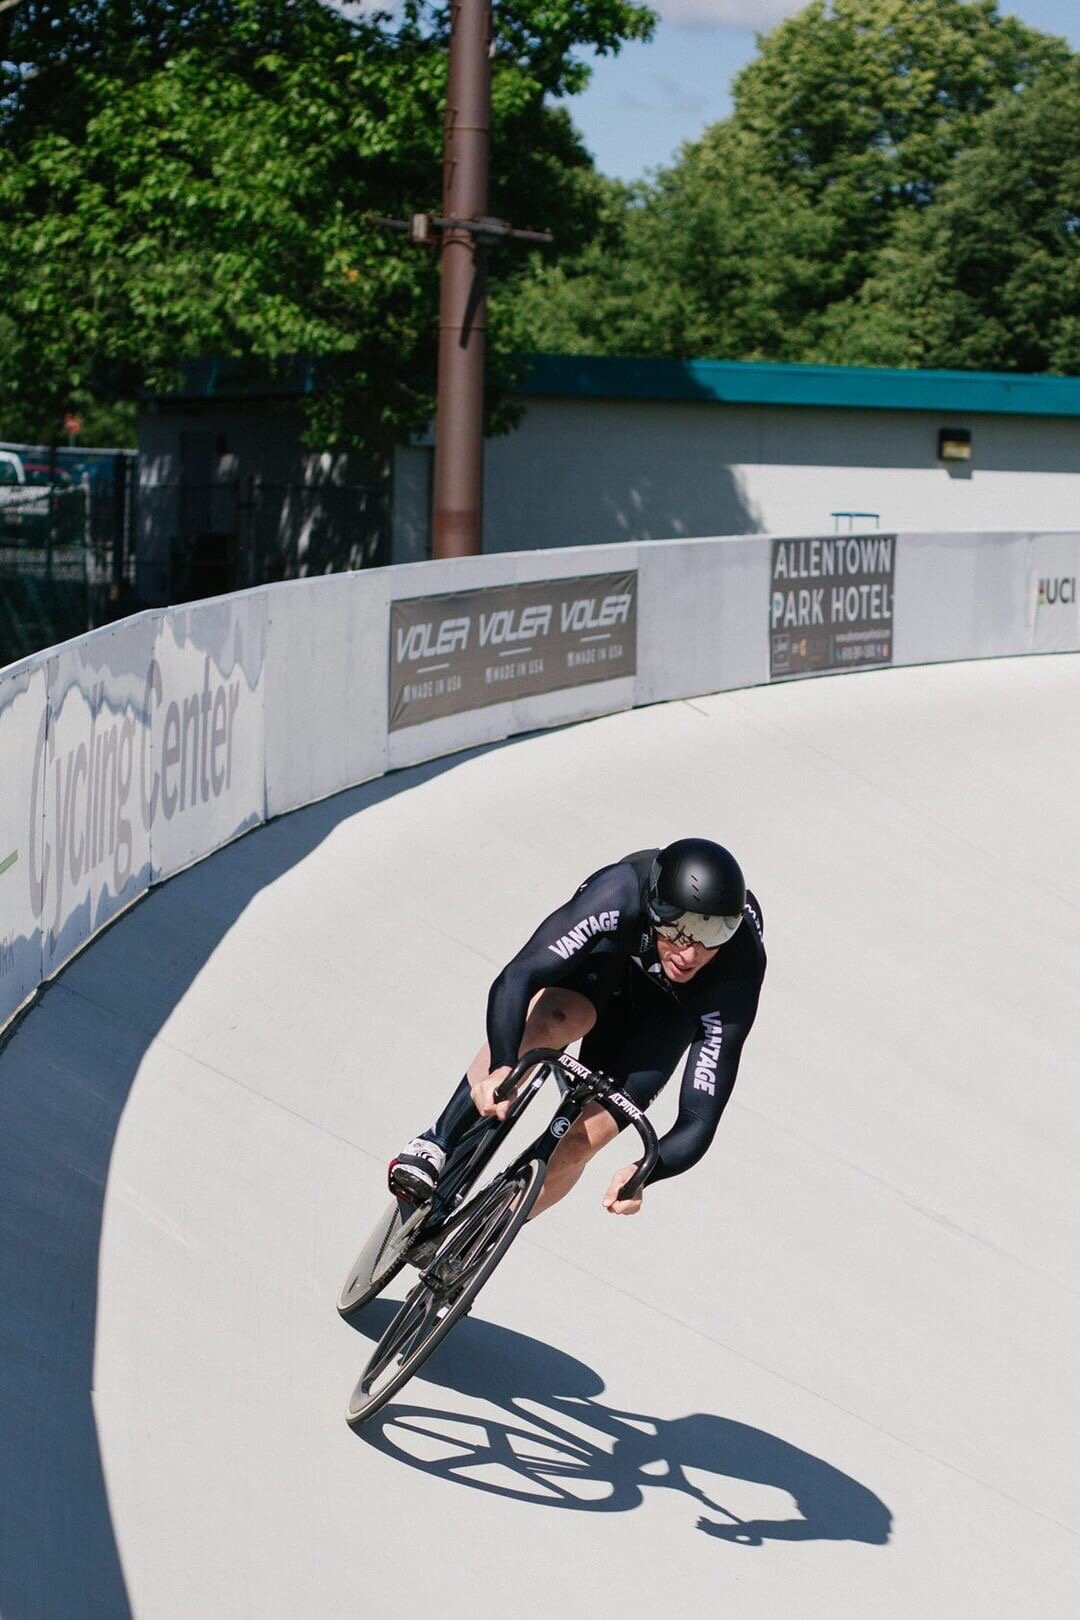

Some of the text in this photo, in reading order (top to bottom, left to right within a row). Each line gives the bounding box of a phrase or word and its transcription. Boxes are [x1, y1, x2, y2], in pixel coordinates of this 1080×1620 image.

[774, 539, 891, 579] ALLENTOWN
[772, 584, 891, 629] PARK HOTEL
[1046, 577, 1075, 604] UCI
[397, 594, 632, 663] VOLER VOLER VOLER
[494, 658, 544, 681] MADE IN USA
[576, 644, 623, 666] MADE IN USA
[411, 675, 462, 699] MADE IN USA
[29, 655, 241, 957] Cycling Center
[547, 910, 620, 960] VANTAGE
[558, 1054, 592, 1080] ALPINA
[693, 1010, 722, 1096] VANTAGE
[608, 1092, 644, 1120] ALPINA
